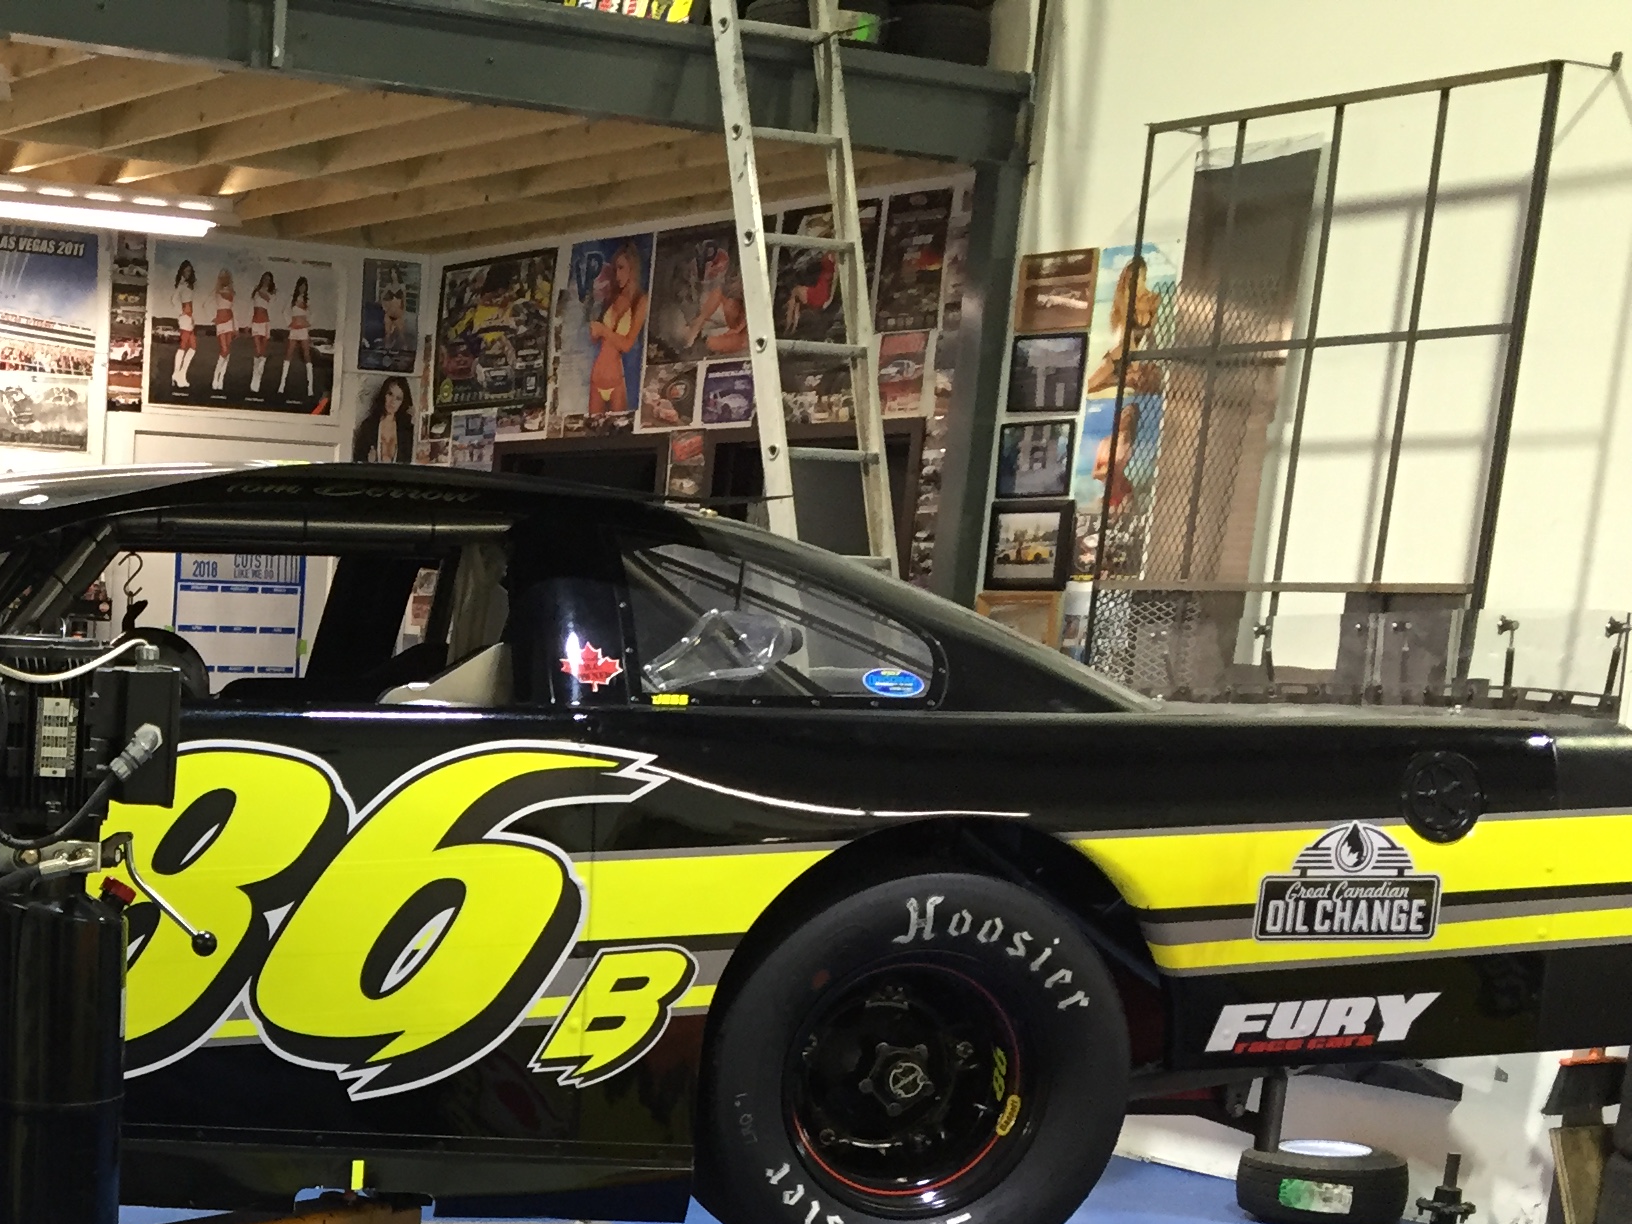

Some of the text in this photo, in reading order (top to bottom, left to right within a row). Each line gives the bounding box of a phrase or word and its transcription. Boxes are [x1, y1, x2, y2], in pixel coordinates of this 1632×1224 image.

[18, 236, 56, 254] VEGAS
[56, 240, 86, 257] 2011
[192, 560, 218, 578] 2018
[1285, 880, 1410, 901] Great Canadian
[1265, 899, 1427, 933] OIL CHANGE
[892, 896, 1090, 1010] Hoosier
[533, 946, 694, 1082] B
[1204, 992, 1443, 1052] FURY
